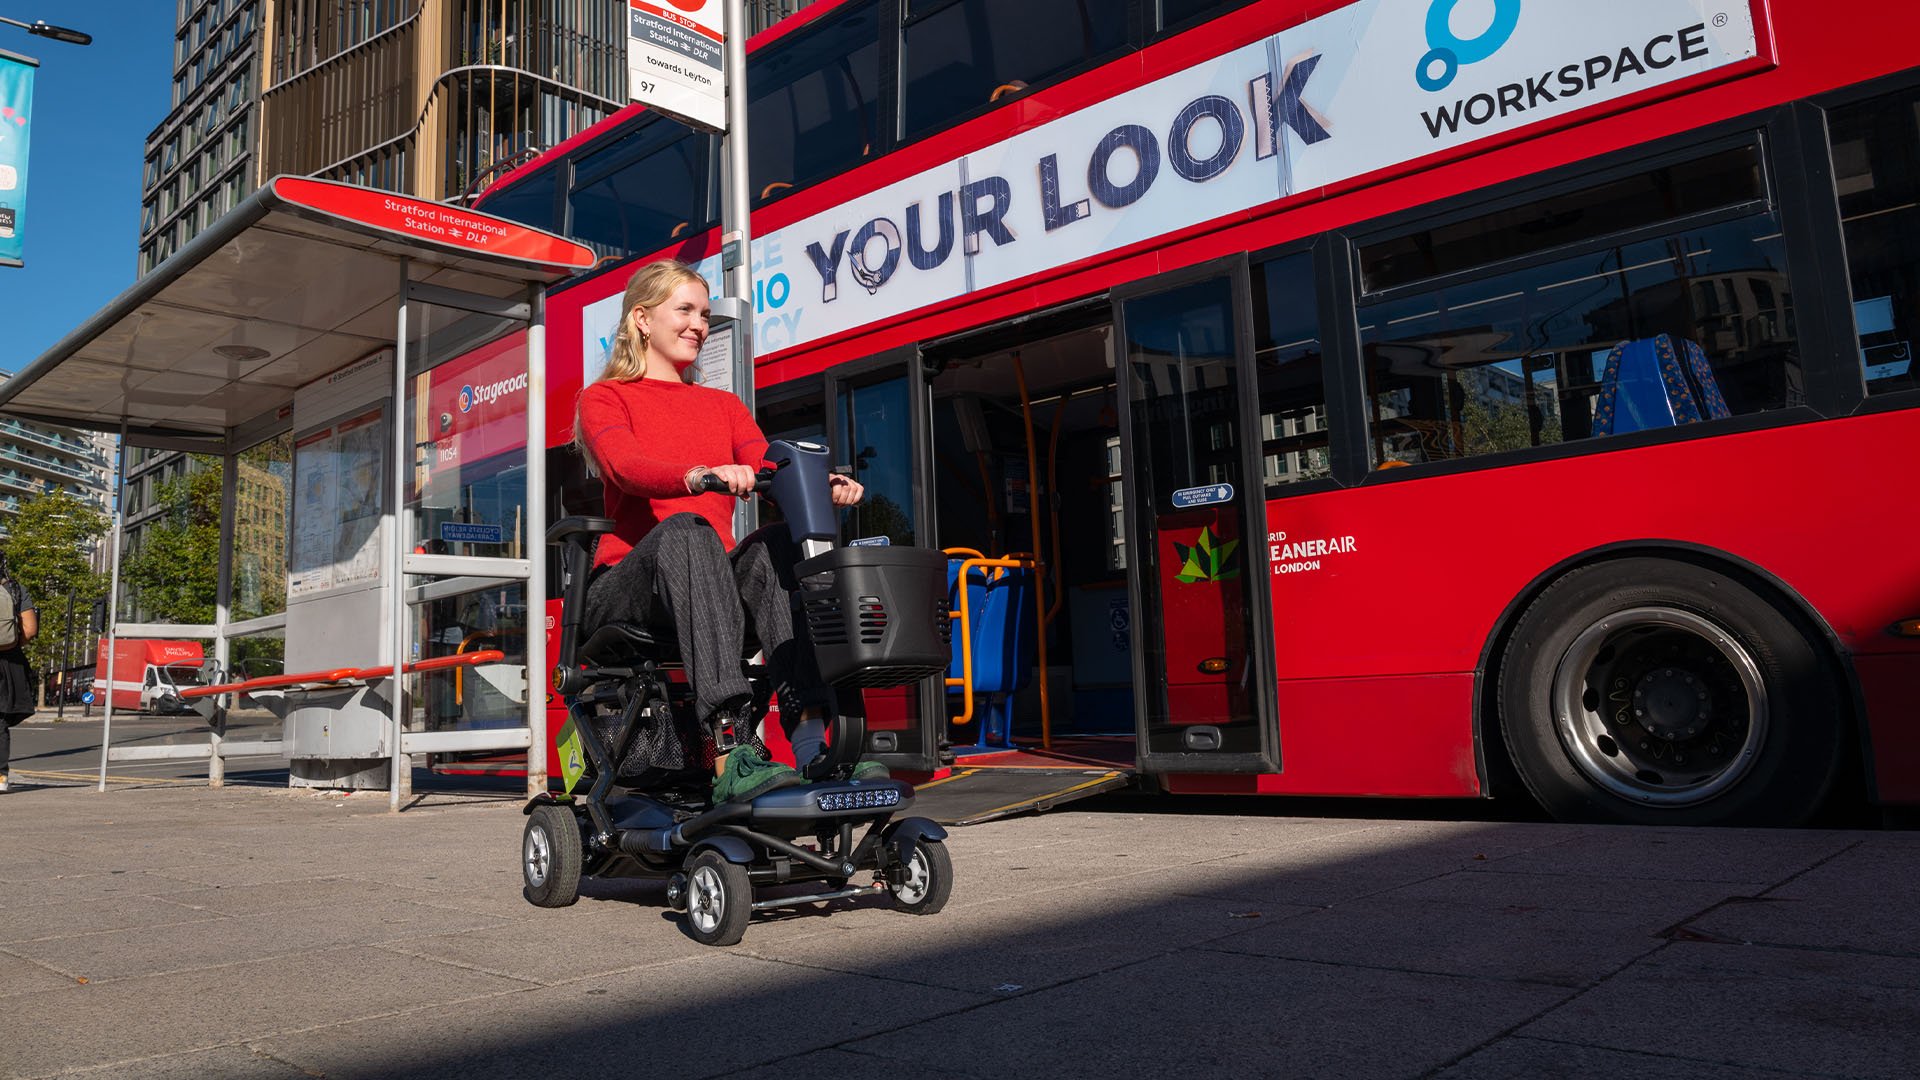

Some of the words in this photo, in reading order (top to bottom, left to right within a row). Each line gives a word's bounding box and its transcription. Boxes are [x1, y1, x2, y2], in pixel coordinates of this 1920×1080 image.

[662, 10, 676, 21] BUS
[679, 16, 697, 29] STOP
[633, 14, 672, 34] Stratford
[672, 27, 721, 56] International
[649, 30, 679, 48] Station
[693, 47, 709, 60] DLR
[646, 55, 682, 74] towards
[684, 68, 712, 86] Leyton
[1420, 23, 1709, 138] WORKSPACE
[640, 81, 655, 94] 97
[805, 175, 1016, 303] YOUR
[1038, 50, 1332, 232] LOOK
[384, 200, 436, 220] Stratford
[439, 211, 507, 237] International
[405, 217, 444, 235] Station
[466, 231, 488, 244] DLR
[473, 372, 528, 405] Stagecoac
[1270, 535, 1357, 562] EANERAIR
[1274, 560, 1321, 575] LONDON
